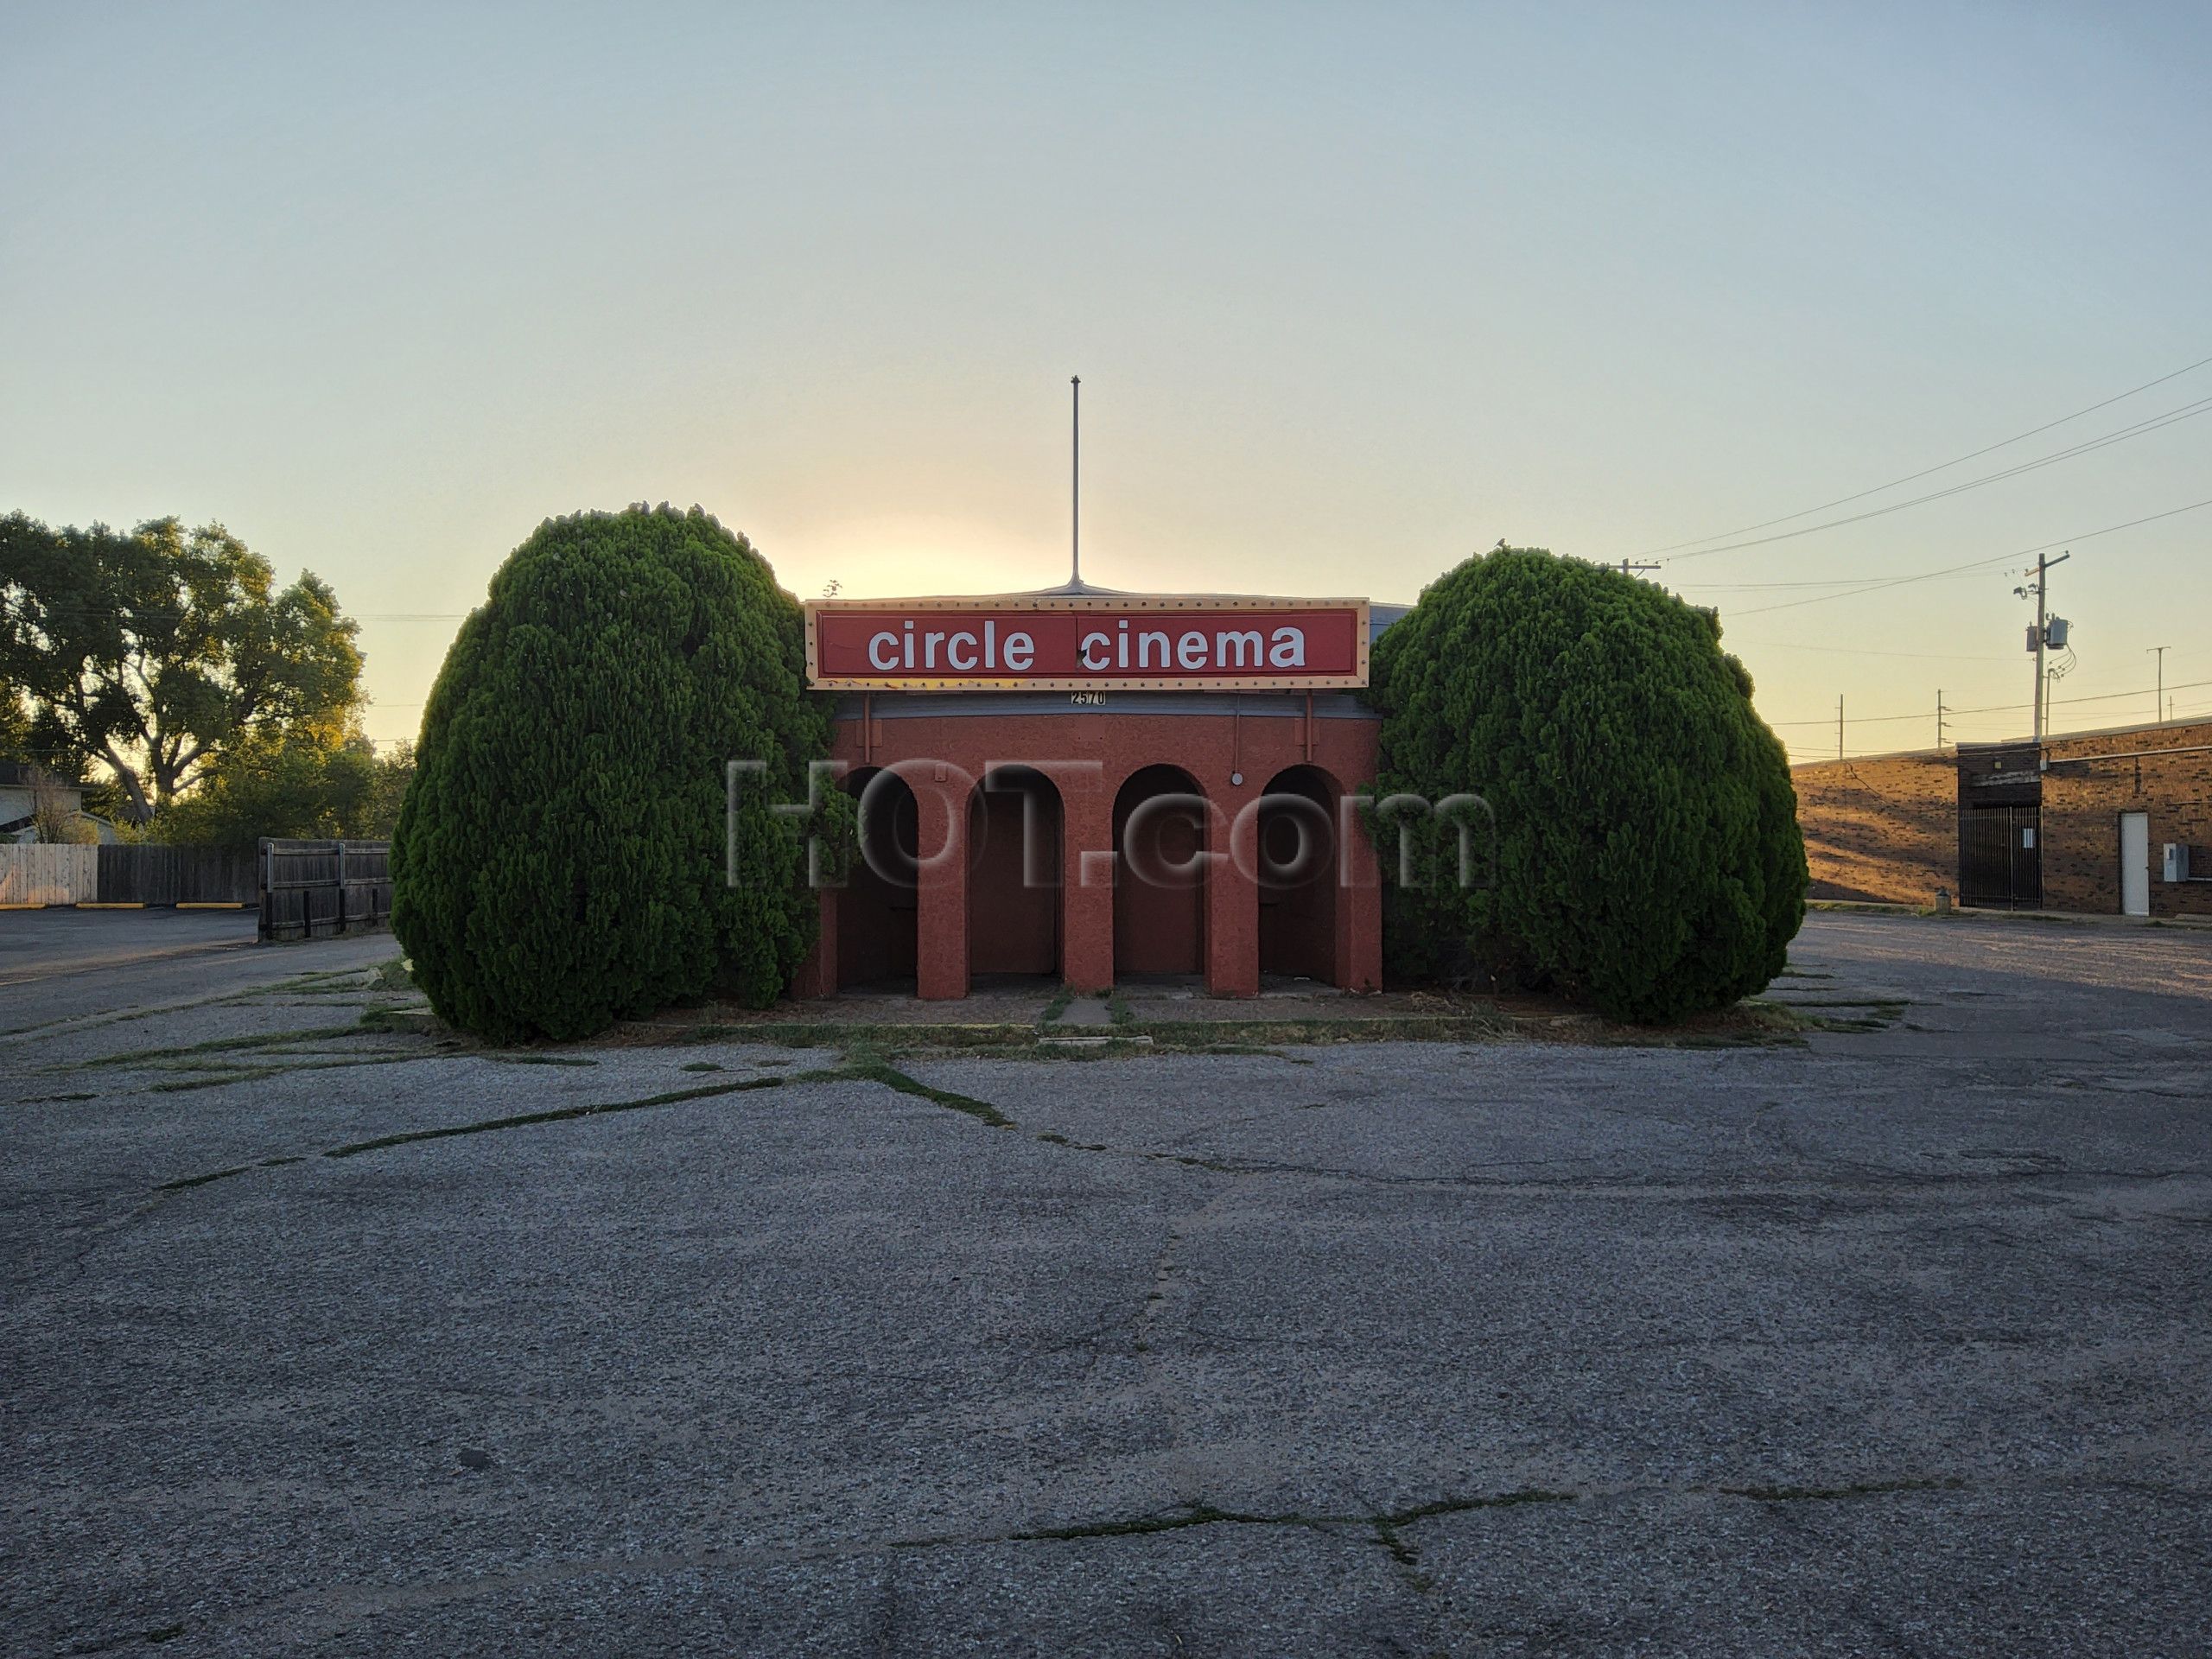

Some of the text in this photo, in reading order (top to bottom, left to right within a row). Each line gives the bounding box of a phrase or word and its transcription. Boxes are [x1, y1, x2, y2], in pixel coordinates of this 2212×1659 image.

[868, 620, 1306, 671] circle cinema
[1072, 691, 1104, 704] 2570
